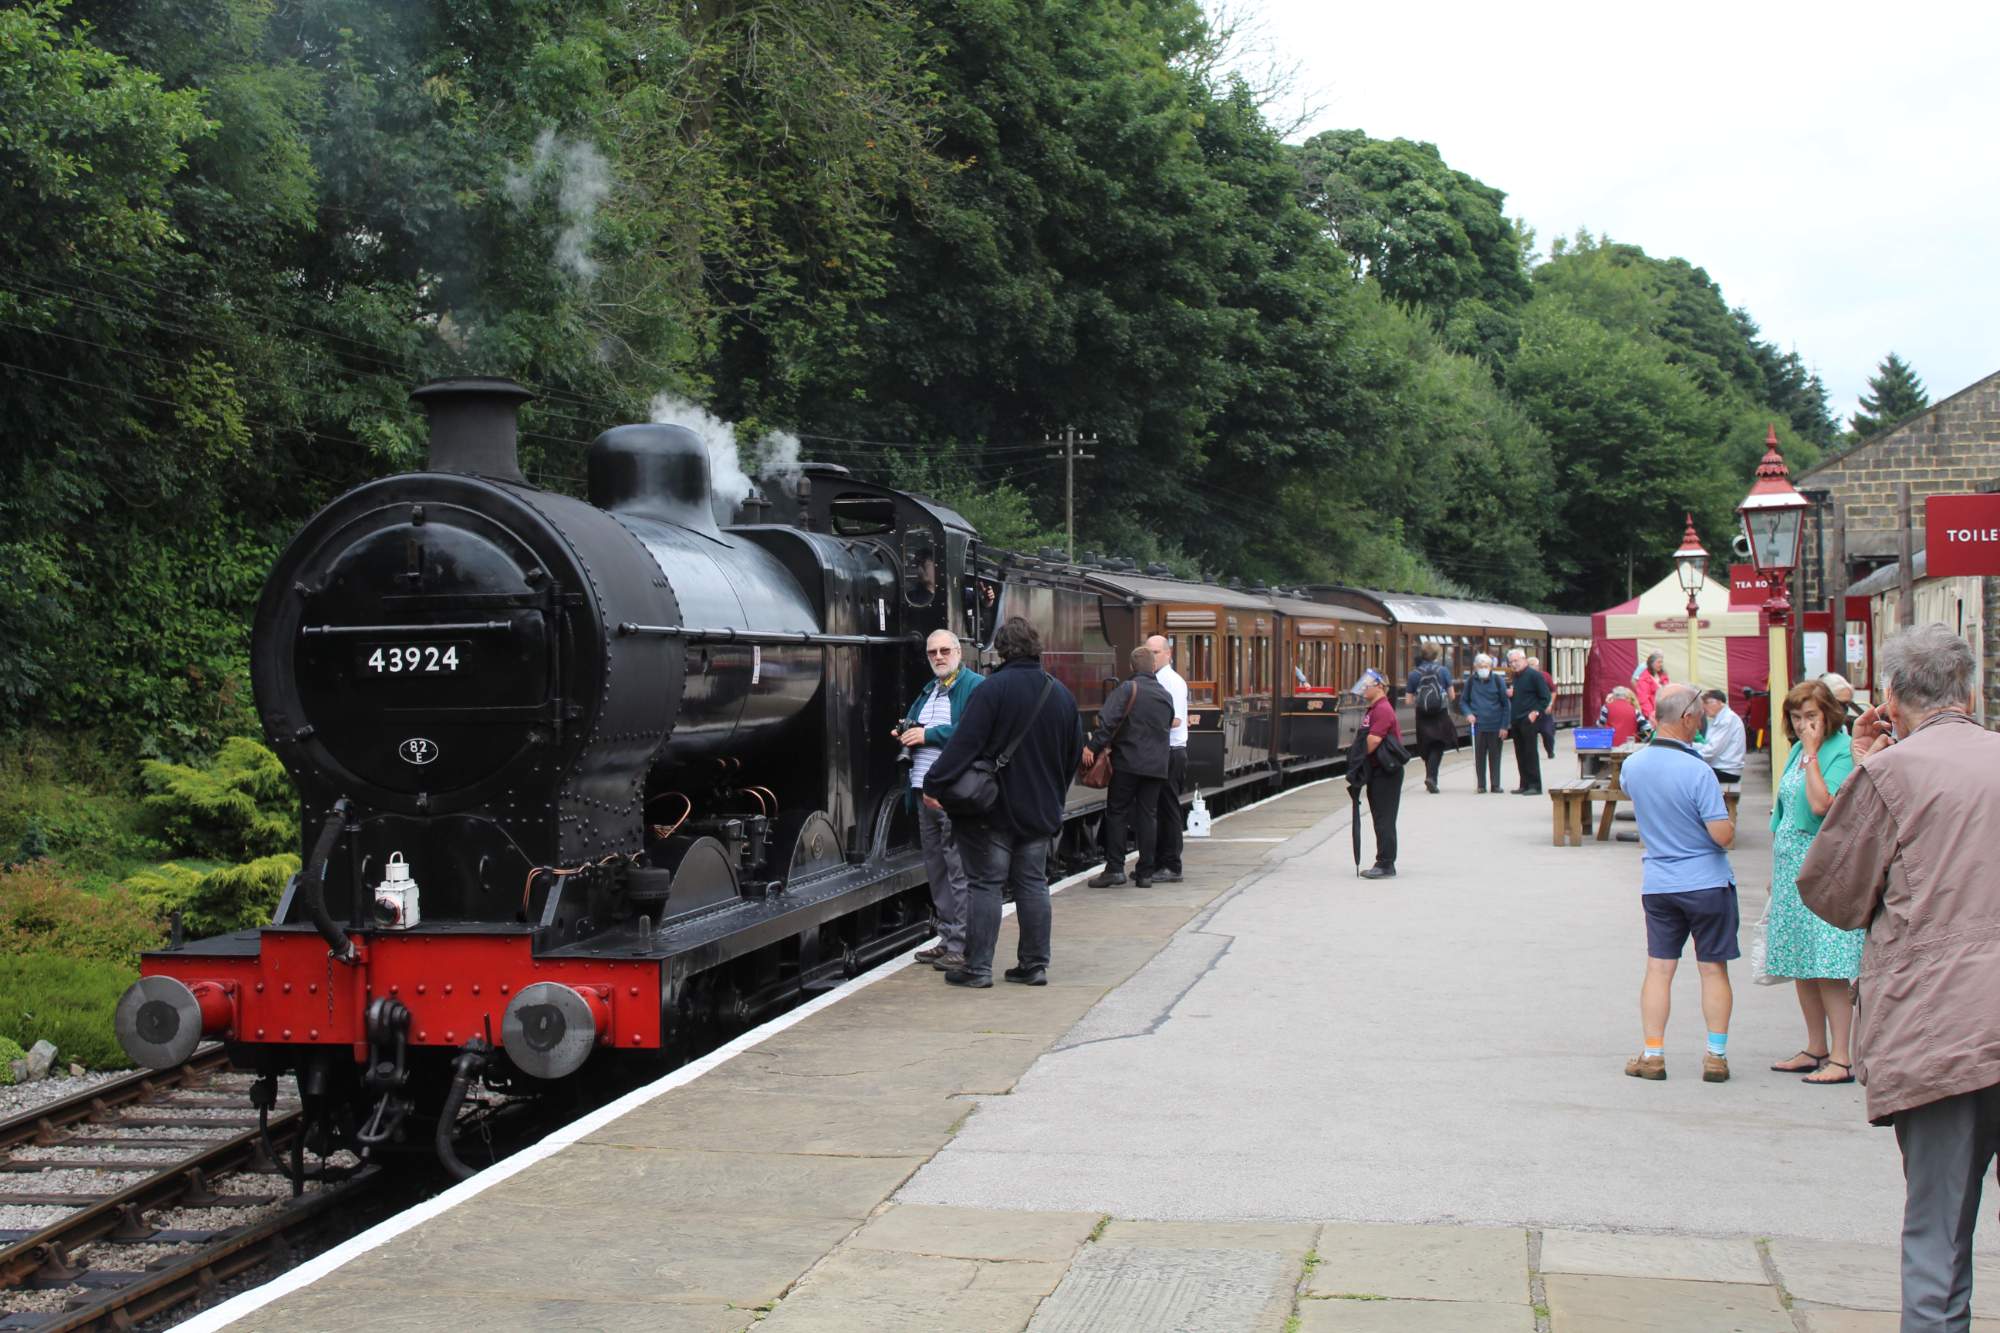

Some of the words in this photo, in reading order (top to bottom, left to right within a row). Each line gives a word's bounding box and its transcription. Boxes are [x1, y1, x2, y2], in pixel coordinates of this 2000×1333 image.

[1946, 529, 2000, 542] TOILE
[1735, 580, 1752, 589] TEA
[1755, 580, 1771, 589] RO
[368, 646, 460, 672] 43924
[410, 740, 427, 752] 82
[416, 752, 423, 763] E
